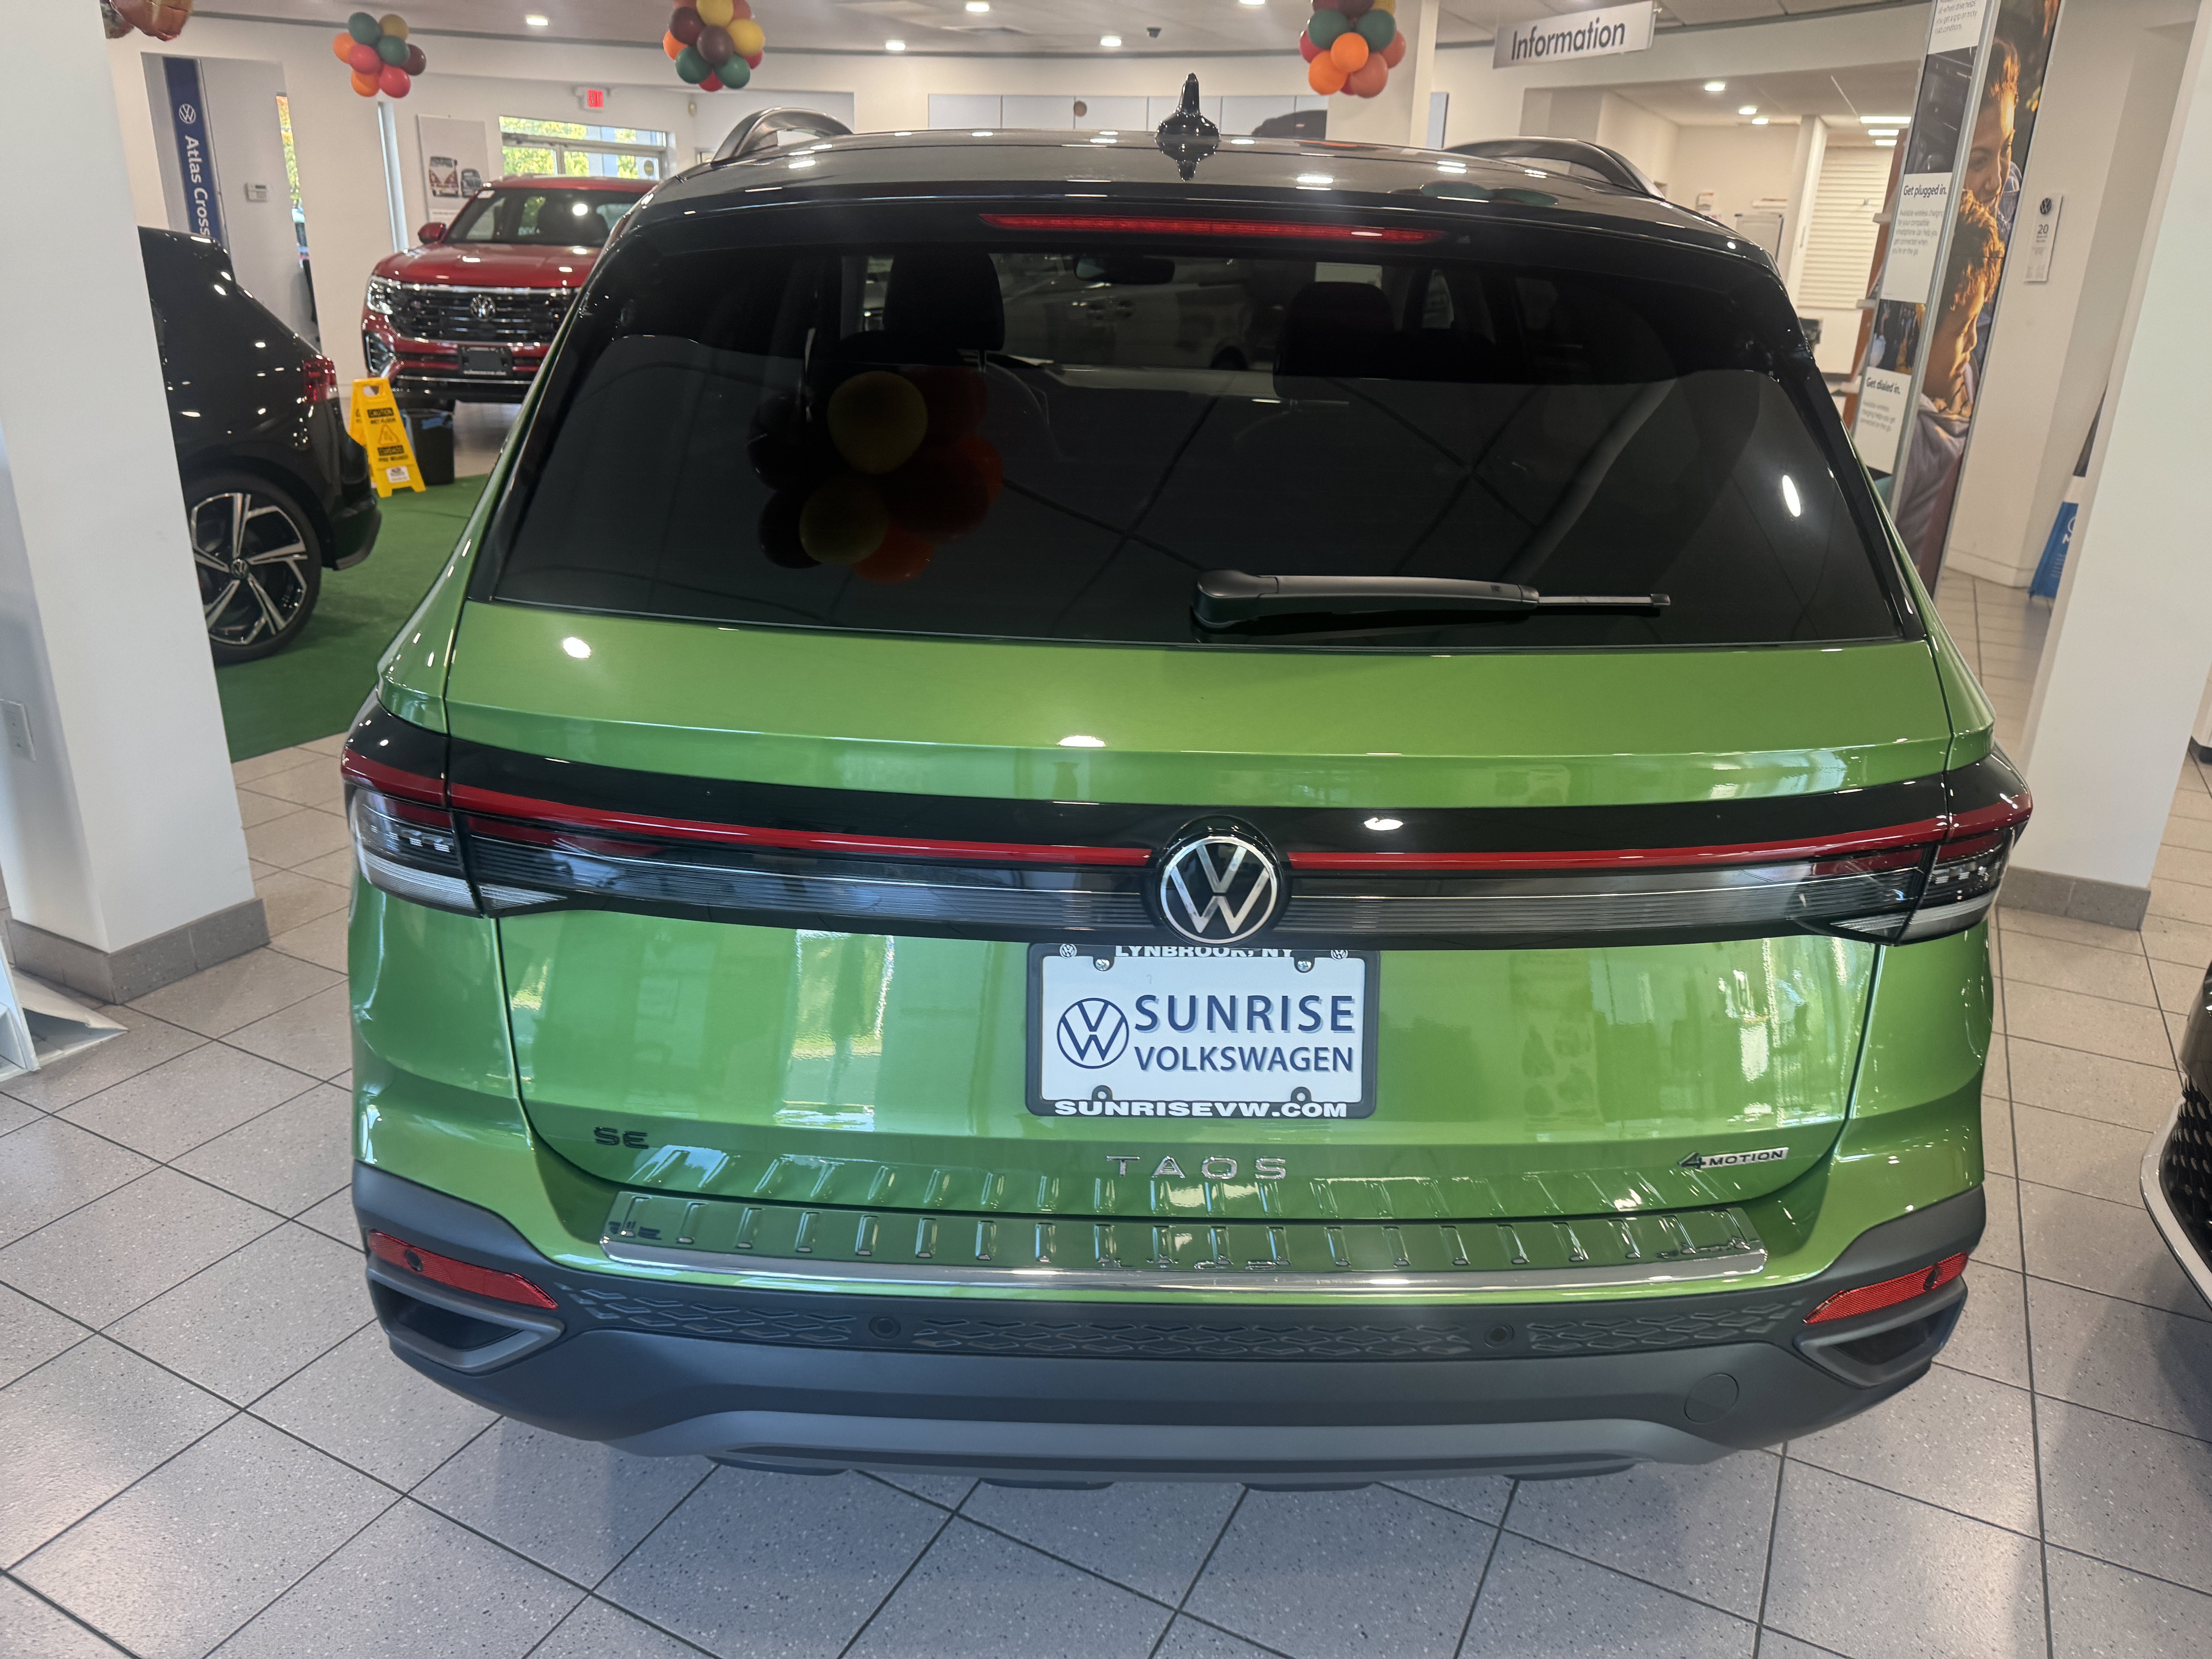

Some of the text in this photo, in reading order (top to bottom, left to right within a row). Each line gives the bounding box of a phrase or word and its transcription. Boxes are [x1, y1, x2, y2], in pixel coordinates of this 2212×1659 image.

[1511, 17, 1625, 60] Information
[185, 135, 210, 235] Atlas Cross
[1904, 185, 1914, 195] Get
[1914, 184, 1940, 198] plugged
[2037, 224, 2049, 234] 20
[1262, 948, 1292, 957] NY
[1135, 994, 1355, 1033] SUNRISE
[1134, 1046, 1354, 1072] VOLKSWAGEN
[1054, 1101, 1347, 1118] SUNRISEVW.COM
[594, 1127, 649, 1149] SE
[1106, 1156, 1286, 1179] TAOS
[1677, 1150, 1783, 1169] 4MOTION
